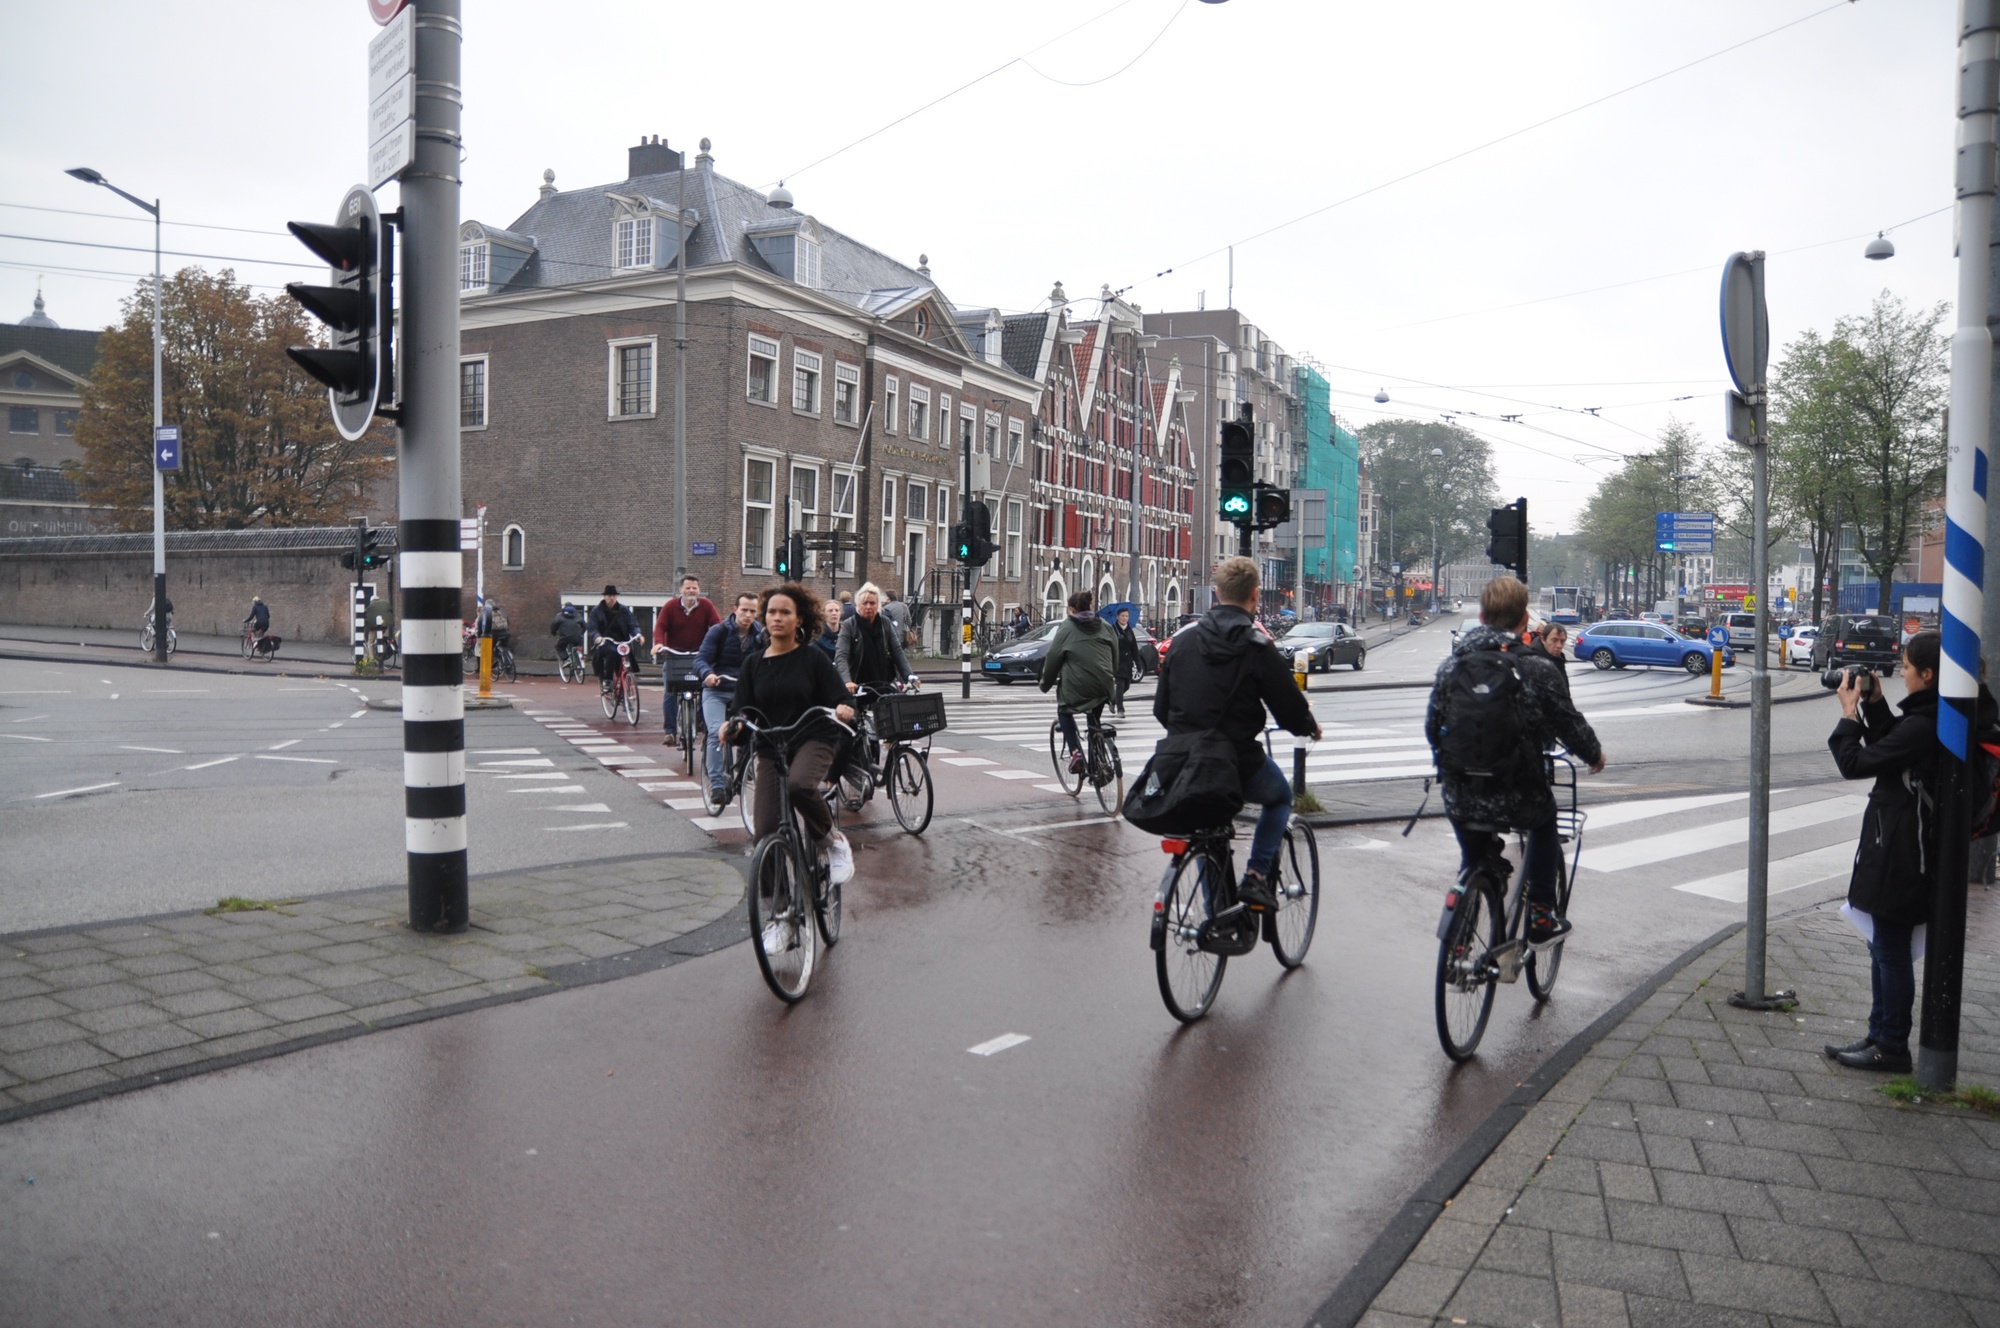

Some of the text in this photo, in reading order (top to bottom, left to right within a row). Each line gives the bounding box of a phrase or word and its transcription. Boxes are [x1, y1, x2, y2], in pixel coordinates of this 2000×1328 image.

[385, 55, 406, 80] verkeer
[372, 85, 404, 121] except local
[380, 111, 396, 134] traffic
